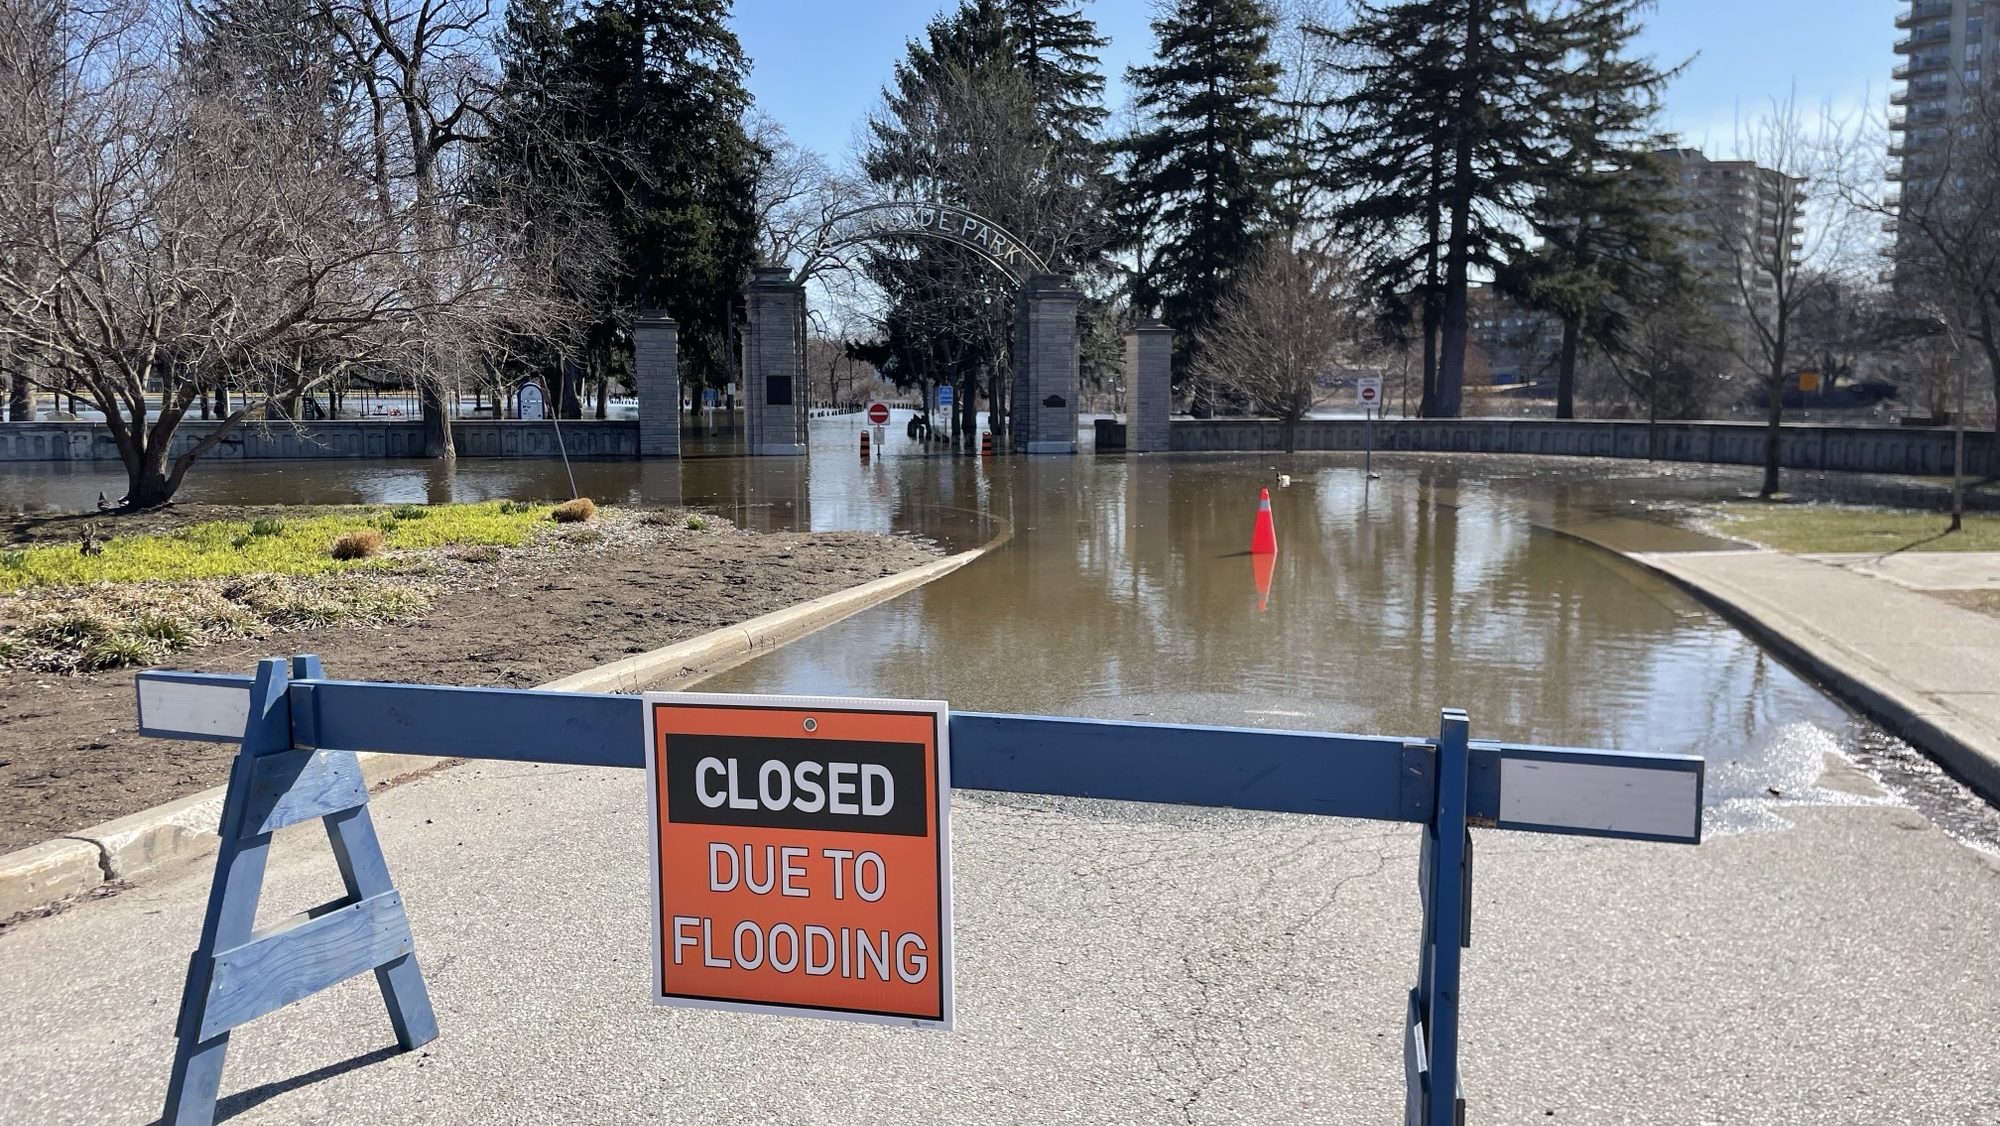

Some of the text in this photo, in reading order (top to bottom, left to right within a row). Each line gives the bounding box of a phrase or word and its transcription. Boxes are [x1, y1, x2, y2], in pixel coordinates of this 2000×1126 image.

[961, 217, 1021, 265] PARK
[695, 756, 895, 817] CLOSED
[708, 841, 887, 902] DUE TO
[672, 915, 929, 984] FLOODING
